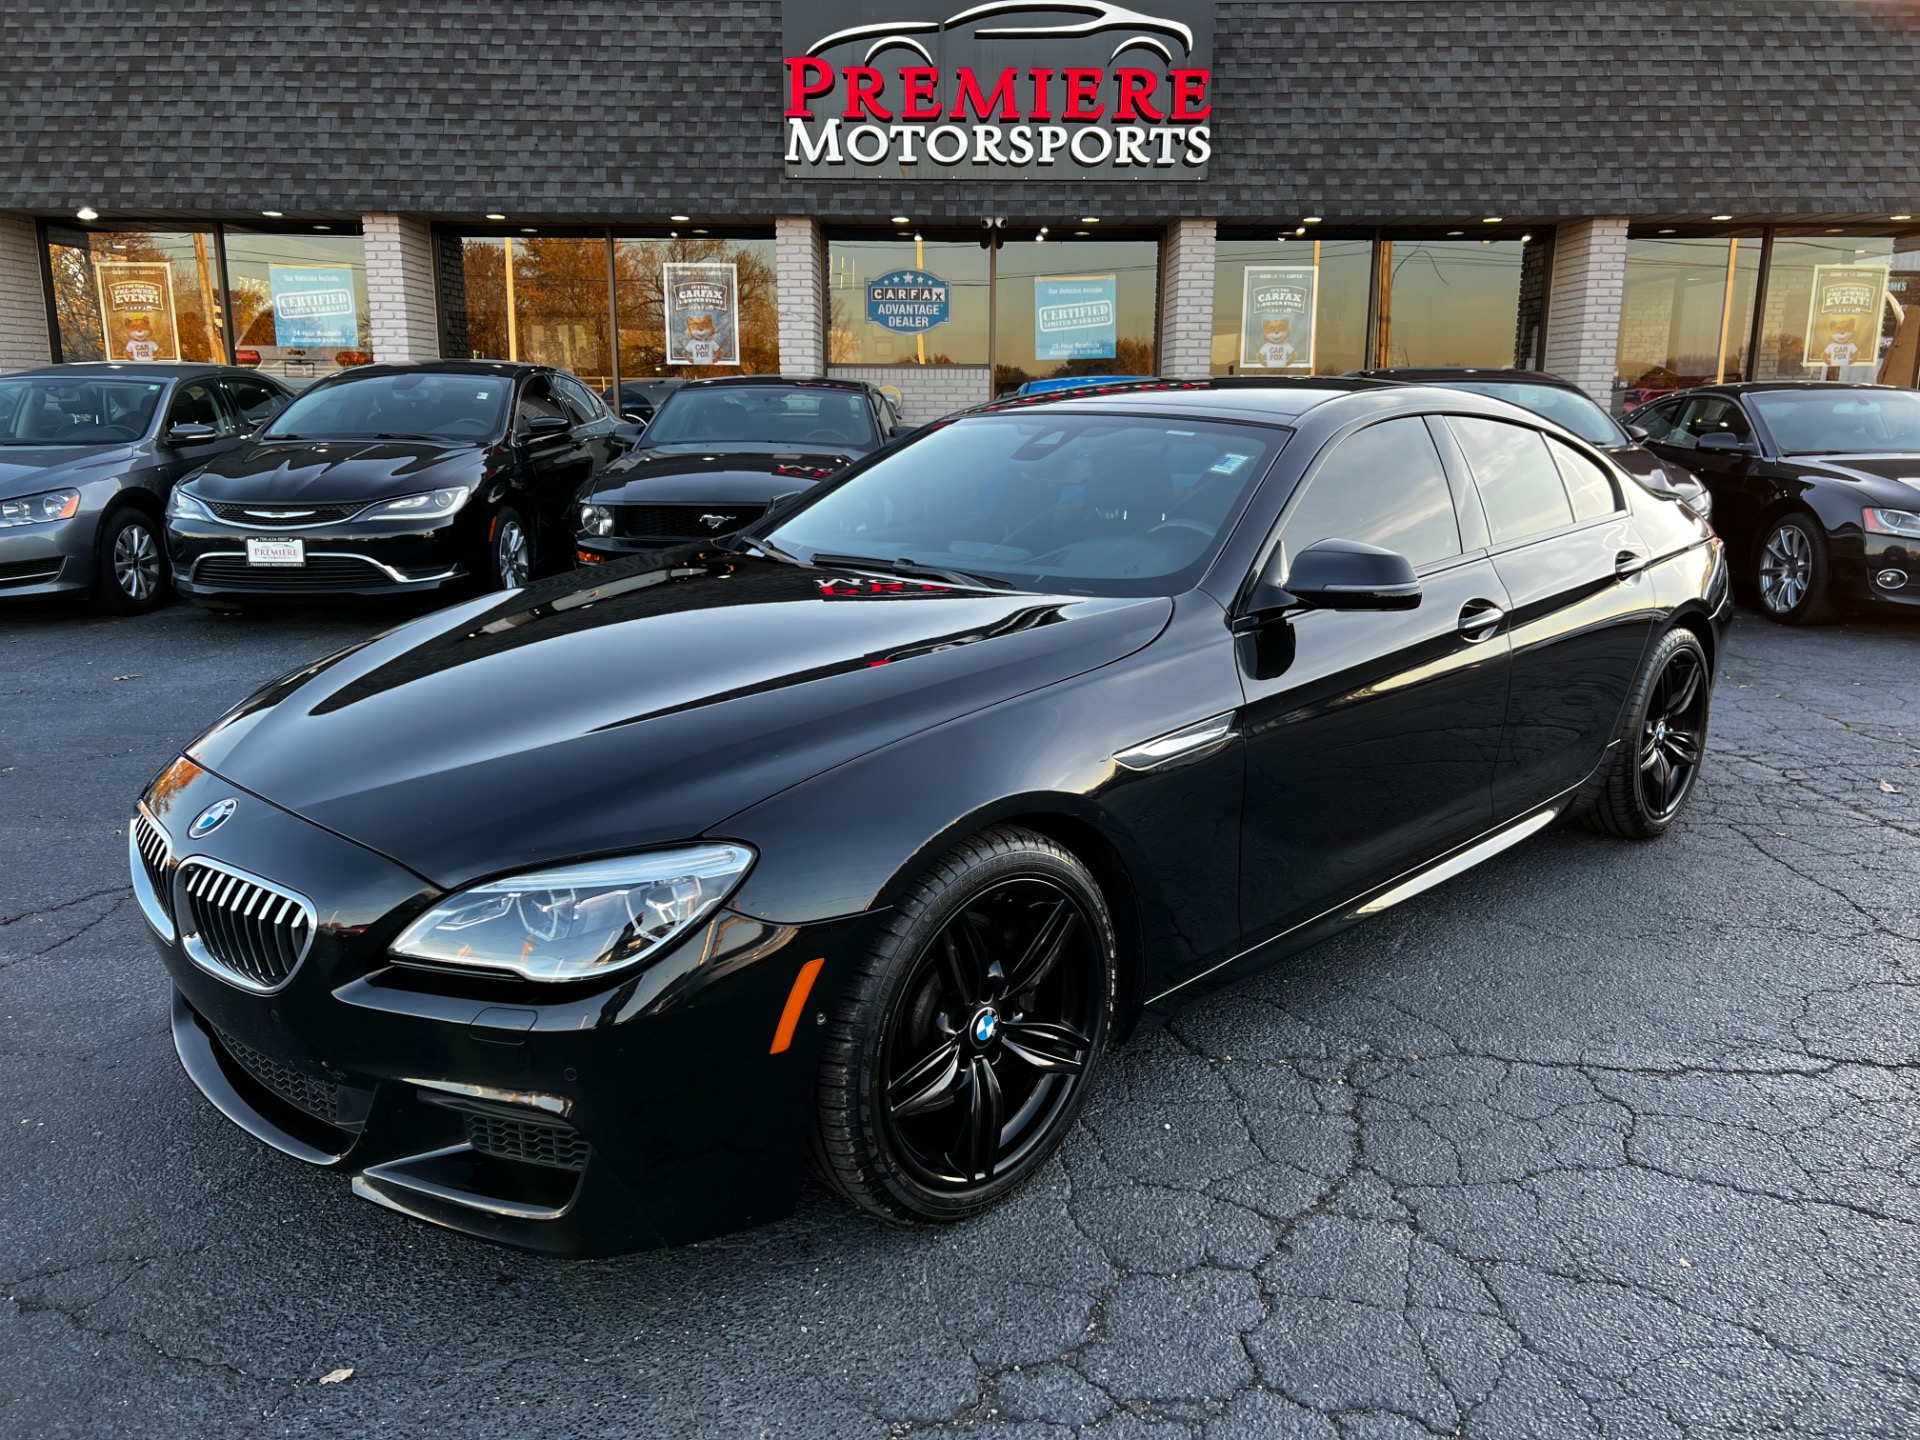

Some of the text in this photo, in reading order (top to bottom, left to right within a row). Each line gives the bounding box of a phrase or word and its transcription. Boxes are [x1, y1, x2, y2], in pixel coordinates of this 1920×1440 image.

[783, 56, 1212, 123] PREMIERE
[784, 118, 1211, 166] MOTORSPORTS
[116, 294, 159, 304] EVENT!
[679, 290, 722, 298] CARFAX
[872, 288, 944, 301] CARFAX
[1258, 292, 1302, 302] CARFAX
[280, 293, 347, 308] CERTIFIED
[1826, 296, 1870, 306] EVENT!
[878, 304, 940, 314] ADVANTAGE
[1043, 304, 1108, 320] CERTIFIED
[888, 316, 929, 327] DEALER
[1044, 316, 1108, 328] LIMITED WARRANTY
